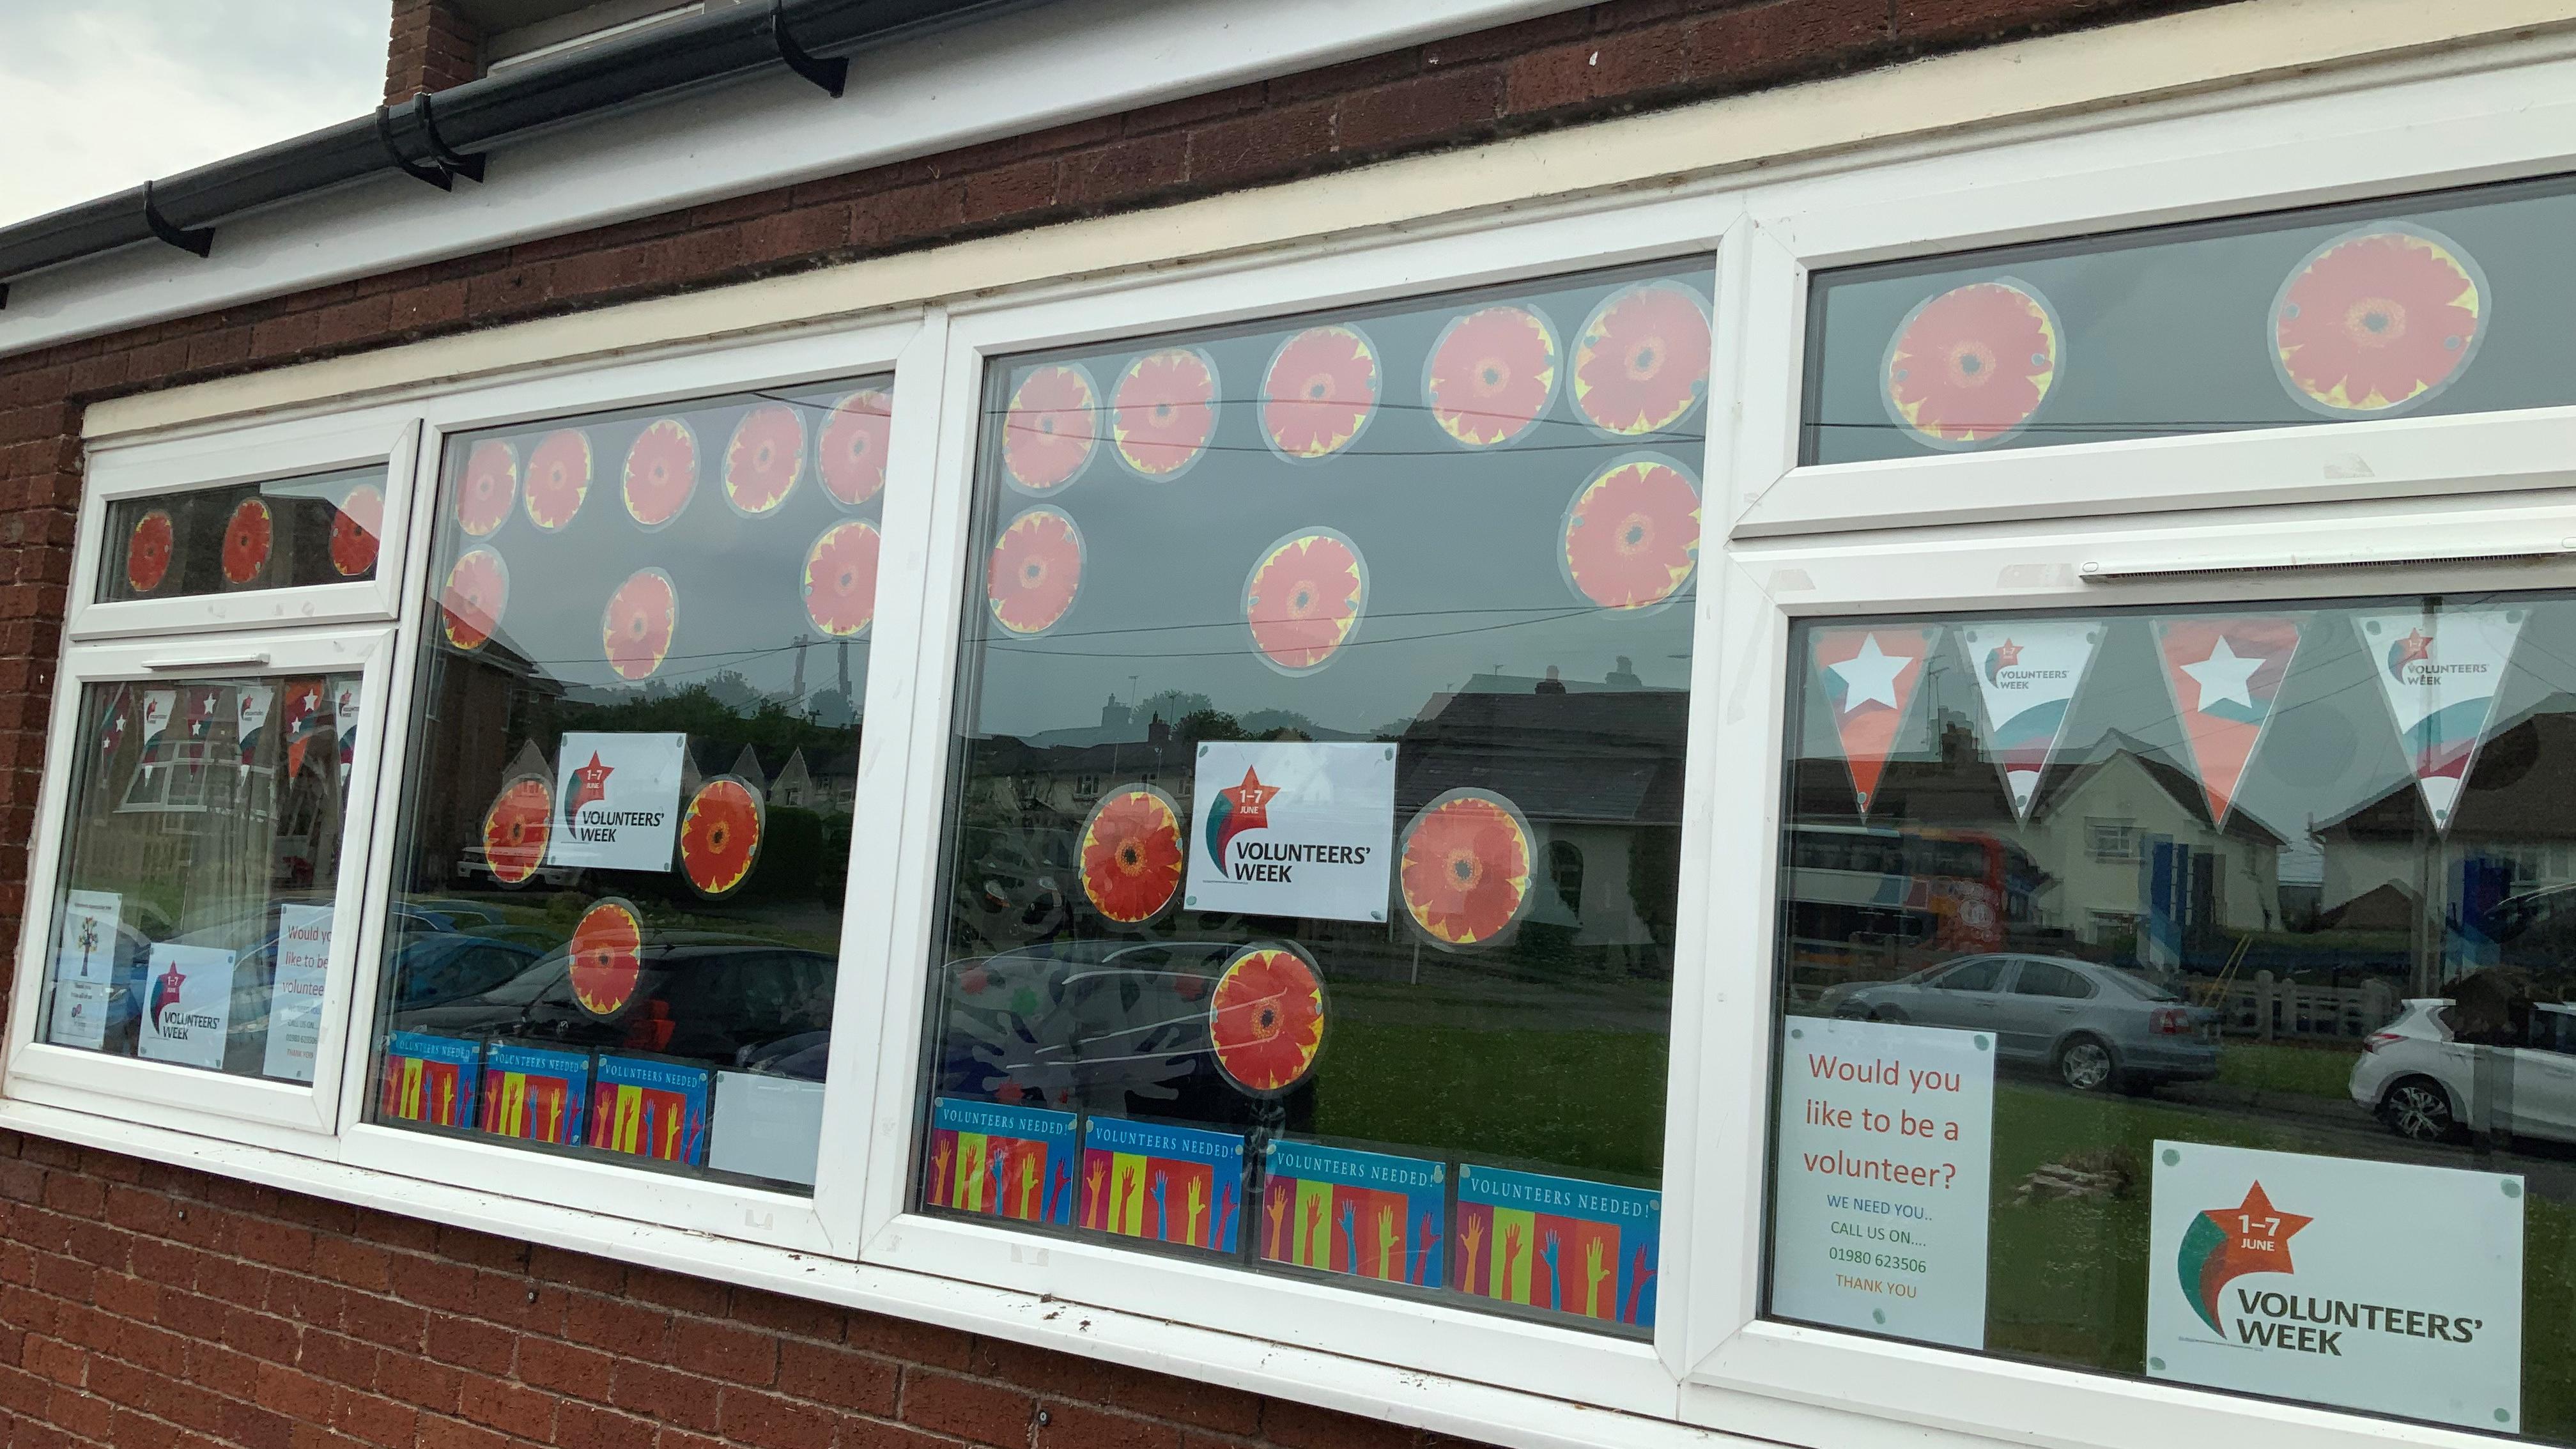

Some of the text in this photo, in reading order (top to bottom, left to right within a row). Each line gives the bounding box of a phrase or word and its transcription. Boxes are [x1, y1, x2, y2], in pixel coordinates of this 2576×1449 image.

[2408, 676, 2441, 685] WEEK
[587, 769, 603, 780] 1-7
[1240, 789, 1263, 803] 1-7
[582, 810, 665, 827] VOLUNTEERS'
[1240, 806, 1259, 814] JUNE
[581, 828, 617, 842] WEEK
[1237, 841, 1371, 864] VOLUNTEERS'
[1235, 862, 1292, 883] WEEK
[288, 925, 332, 945] Would yo
[286, 951, 328, 969] like to be
[282, 979, 324, 996] voluntee
[164, 1011, 220, 1030] VOLUNTEERS'
[163, 1026, 189, 1040] WEEK
[495, 1053, 546, 1069] VOLUNTEERS
[605, 1064, 662, 1082] VOLUNTEERS
[1809, 1053, 1960, 1094] Would you
[943, 1108, 1068, 1135] VOLUNTEERS NEEDED!
[1807, 1099, 1959, 1141] like to be a
[1096, 1127, 1233, 1159] VOLUNTEERS NEEDED!
[1277, 1152, 1433, 1188] VOLUNTEERS NEEDED!
[1803, 1149, 1957, 1189] volunteer?
[1471, 1178, 1649, 1218] VOLUNTEERS NEEDED!
[1827, 1195, 1849, 1209] WE
[1853, 1198, 1890, 1214] NEED
[1831, 1221, 1863, 1237] CALL
[1867, 1226, 1885, 1240] US
[2237, 1214, 2281, 1237] 1-7
[2241, 1239, 2275, 1251] JUNE
[1830, 1246, 1926, 1273] 01980 623506
[1835, 1273, 1917, 1298] THANK YOU
[2237, 1288, 2483, 1343] VOLUNTEERS'
[2237, 1319, 2342, 1356] WEEK
